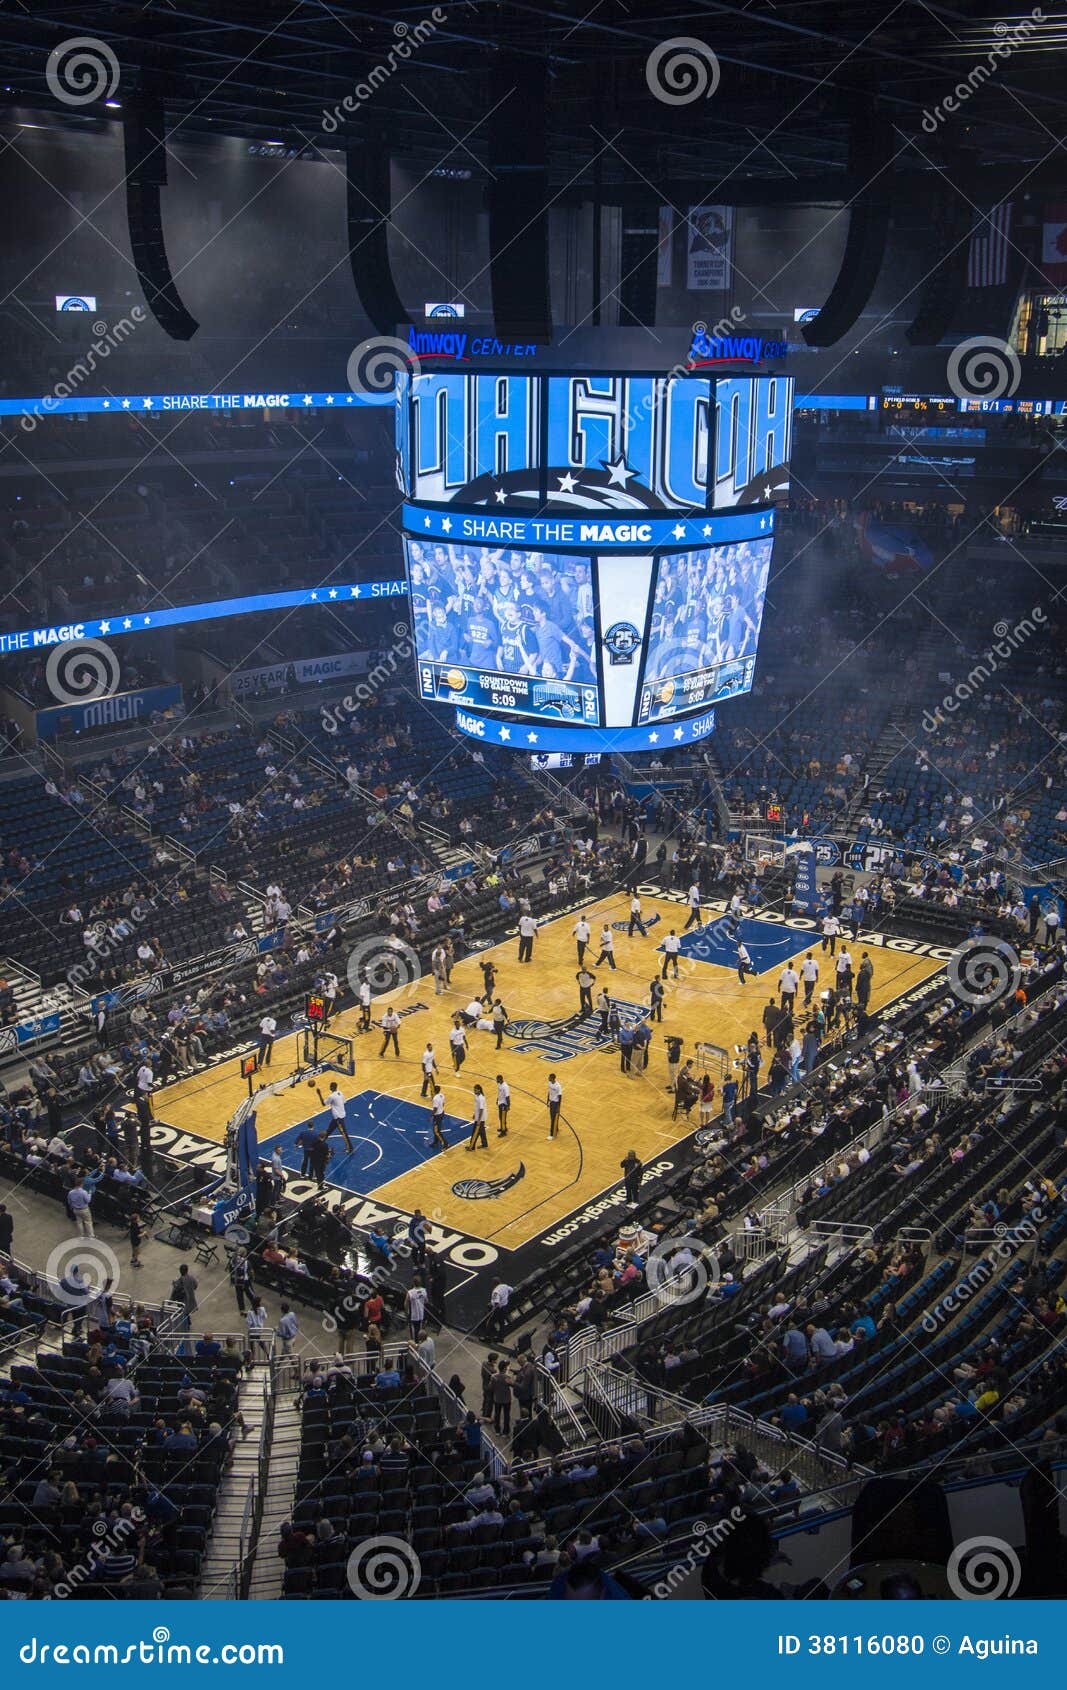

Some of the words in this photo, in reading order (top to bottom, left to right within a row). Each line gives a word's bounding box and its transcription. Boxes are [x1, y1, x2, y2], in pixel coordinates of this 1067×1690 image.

[408, 326, 468, 360] Amway
[690, 328, 763, 364] Amway
[163, 396, 208, 409] SHARE
[212, 395, 240, 408] THE
[243, 394, 290, 407] MAGIC
[463, 519, 526, 539] SHARE
[532, 523, 574, 541] THE
[580, 525, 653, 542] MAGIC
[0, 633, 30, 652] THE
[33, 624, 85, 646] MAGIC
[302, 660, 342, 677] MAGIC
[421, 668, 433, 693] IND
[479, 675, 528, 688] COUNTDOWN
[490, 684, 511, 692] GAME
[511, 686, 528, 695] TIME
[492, 693, 516, 707] 5:09
[584, 690, 595, 718] ORL
[641, 690, 651, 717] IND
[816, 845, 832, 860] 25
